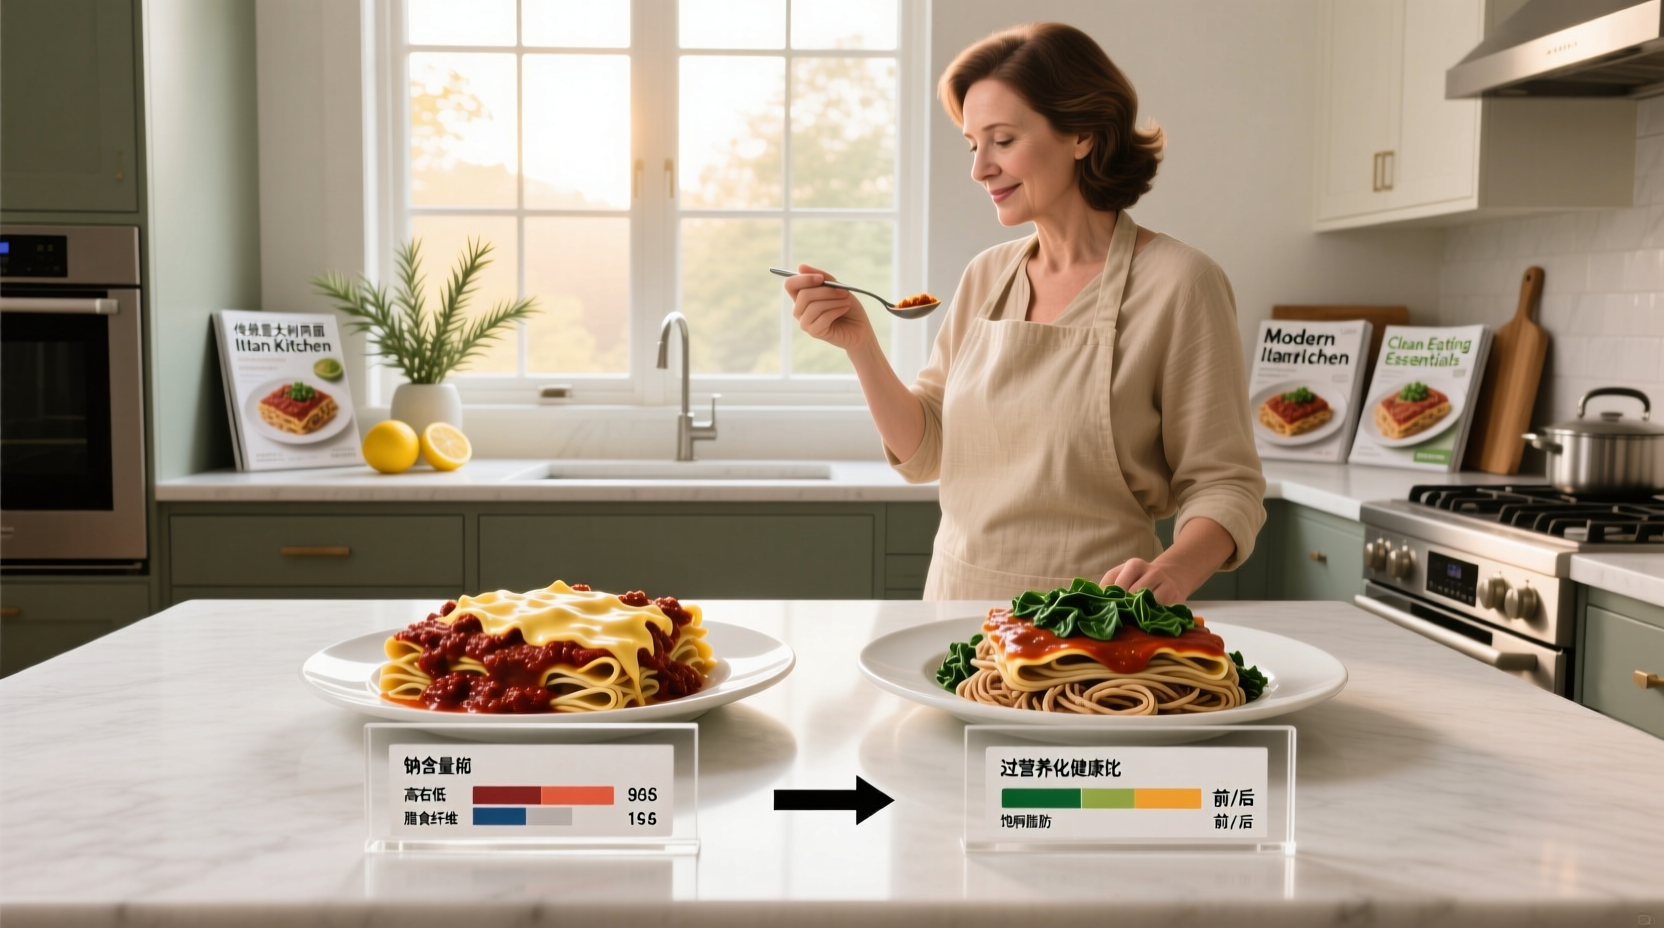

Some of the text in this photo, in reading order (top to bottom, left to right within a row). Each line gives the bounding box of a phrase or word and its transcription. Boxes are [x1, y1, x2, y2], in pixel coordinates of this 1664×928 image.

[275, 338, 331, 352] Kitchen
[1264, 328, 1335, 346] Modern
[1387, 336, 1472, 354] Clean Eating
[1385, 352, 1460, 367] Essentials
[1212, 788, 1255, 808] 前/后
[1213, 813, 1254, 829] 前/后
